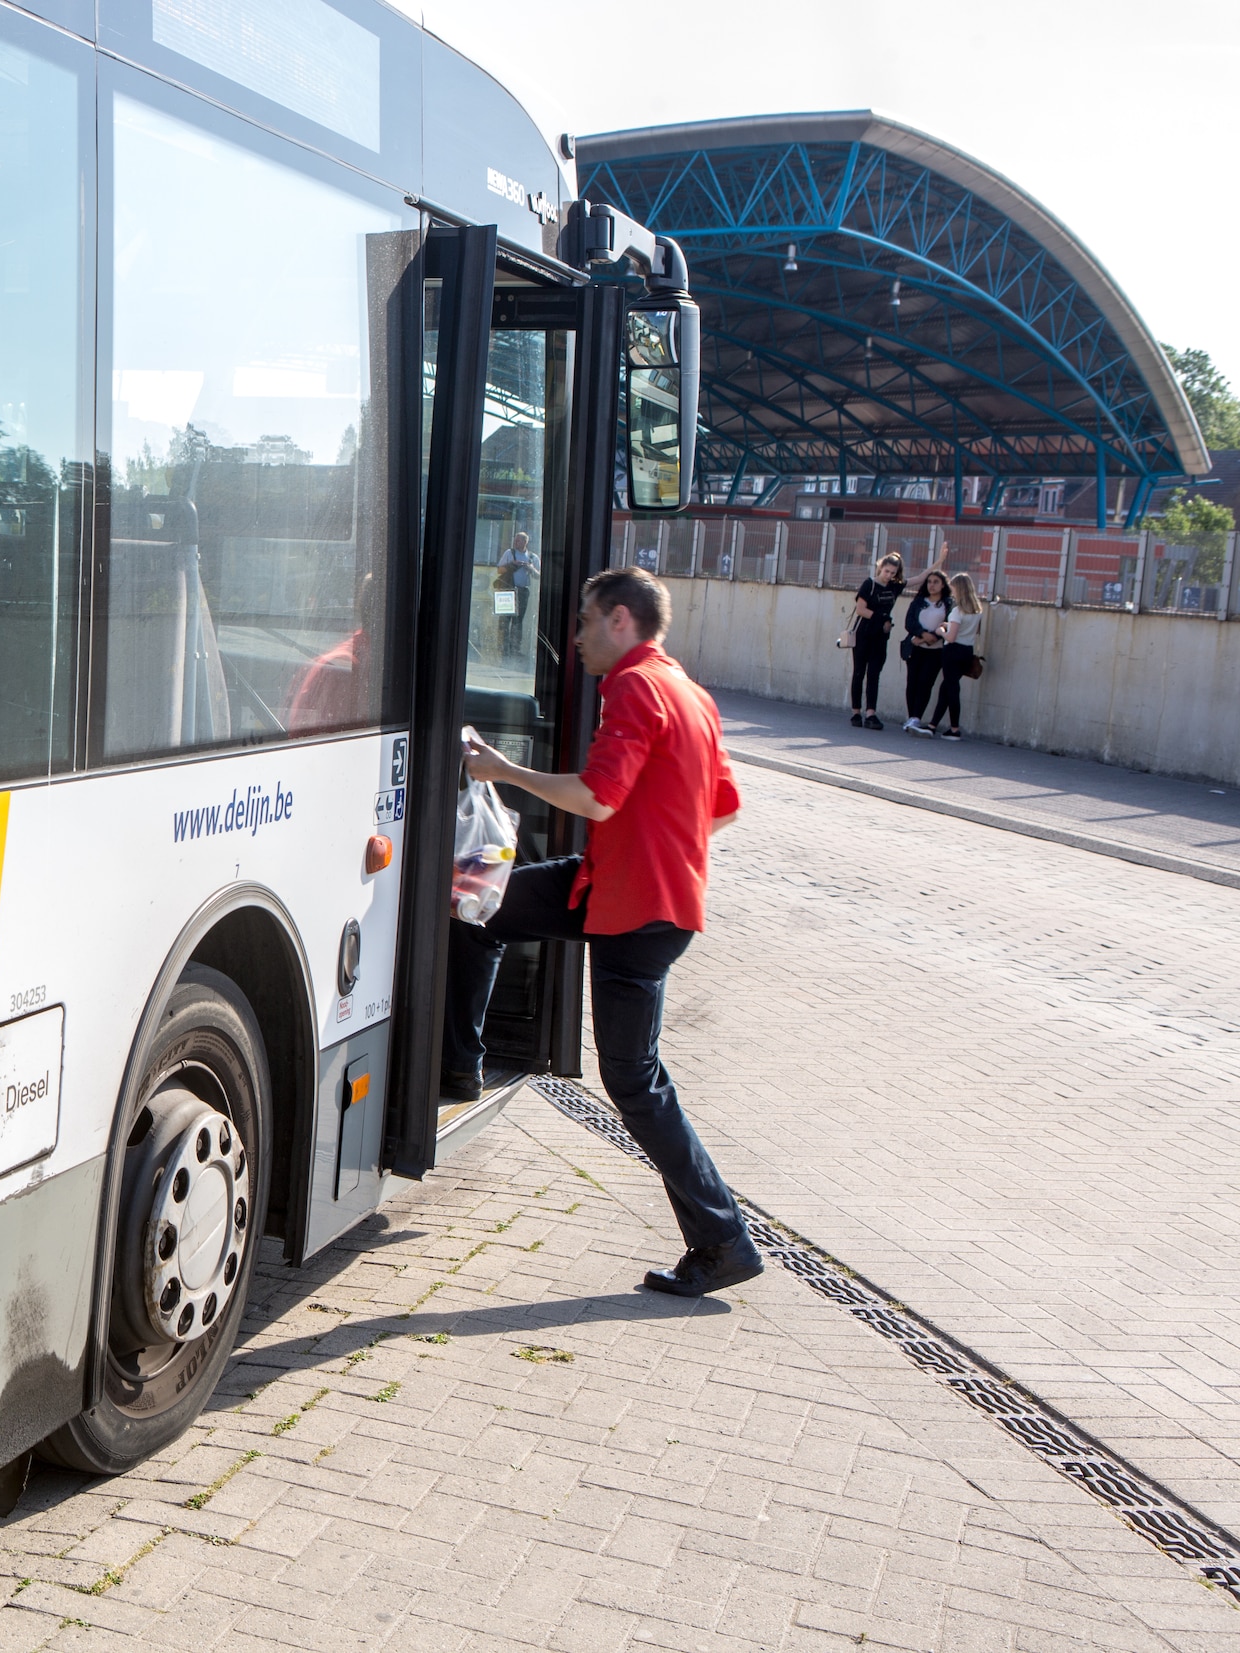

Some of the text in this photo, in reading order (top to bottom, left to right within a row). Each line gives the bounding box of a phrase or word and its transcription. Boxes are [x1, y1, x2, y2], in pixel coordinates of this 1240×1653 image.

[174, 781, 293, 843] www.delijn.be
[235, 863, 240, 878] 7
[10, 984, 47, 1013] 304253
[365, 1002, 375, 1020] 100
[6, 1069, 49, 1113] Diesel
[175, 1309, 226, 1395] NLOP
